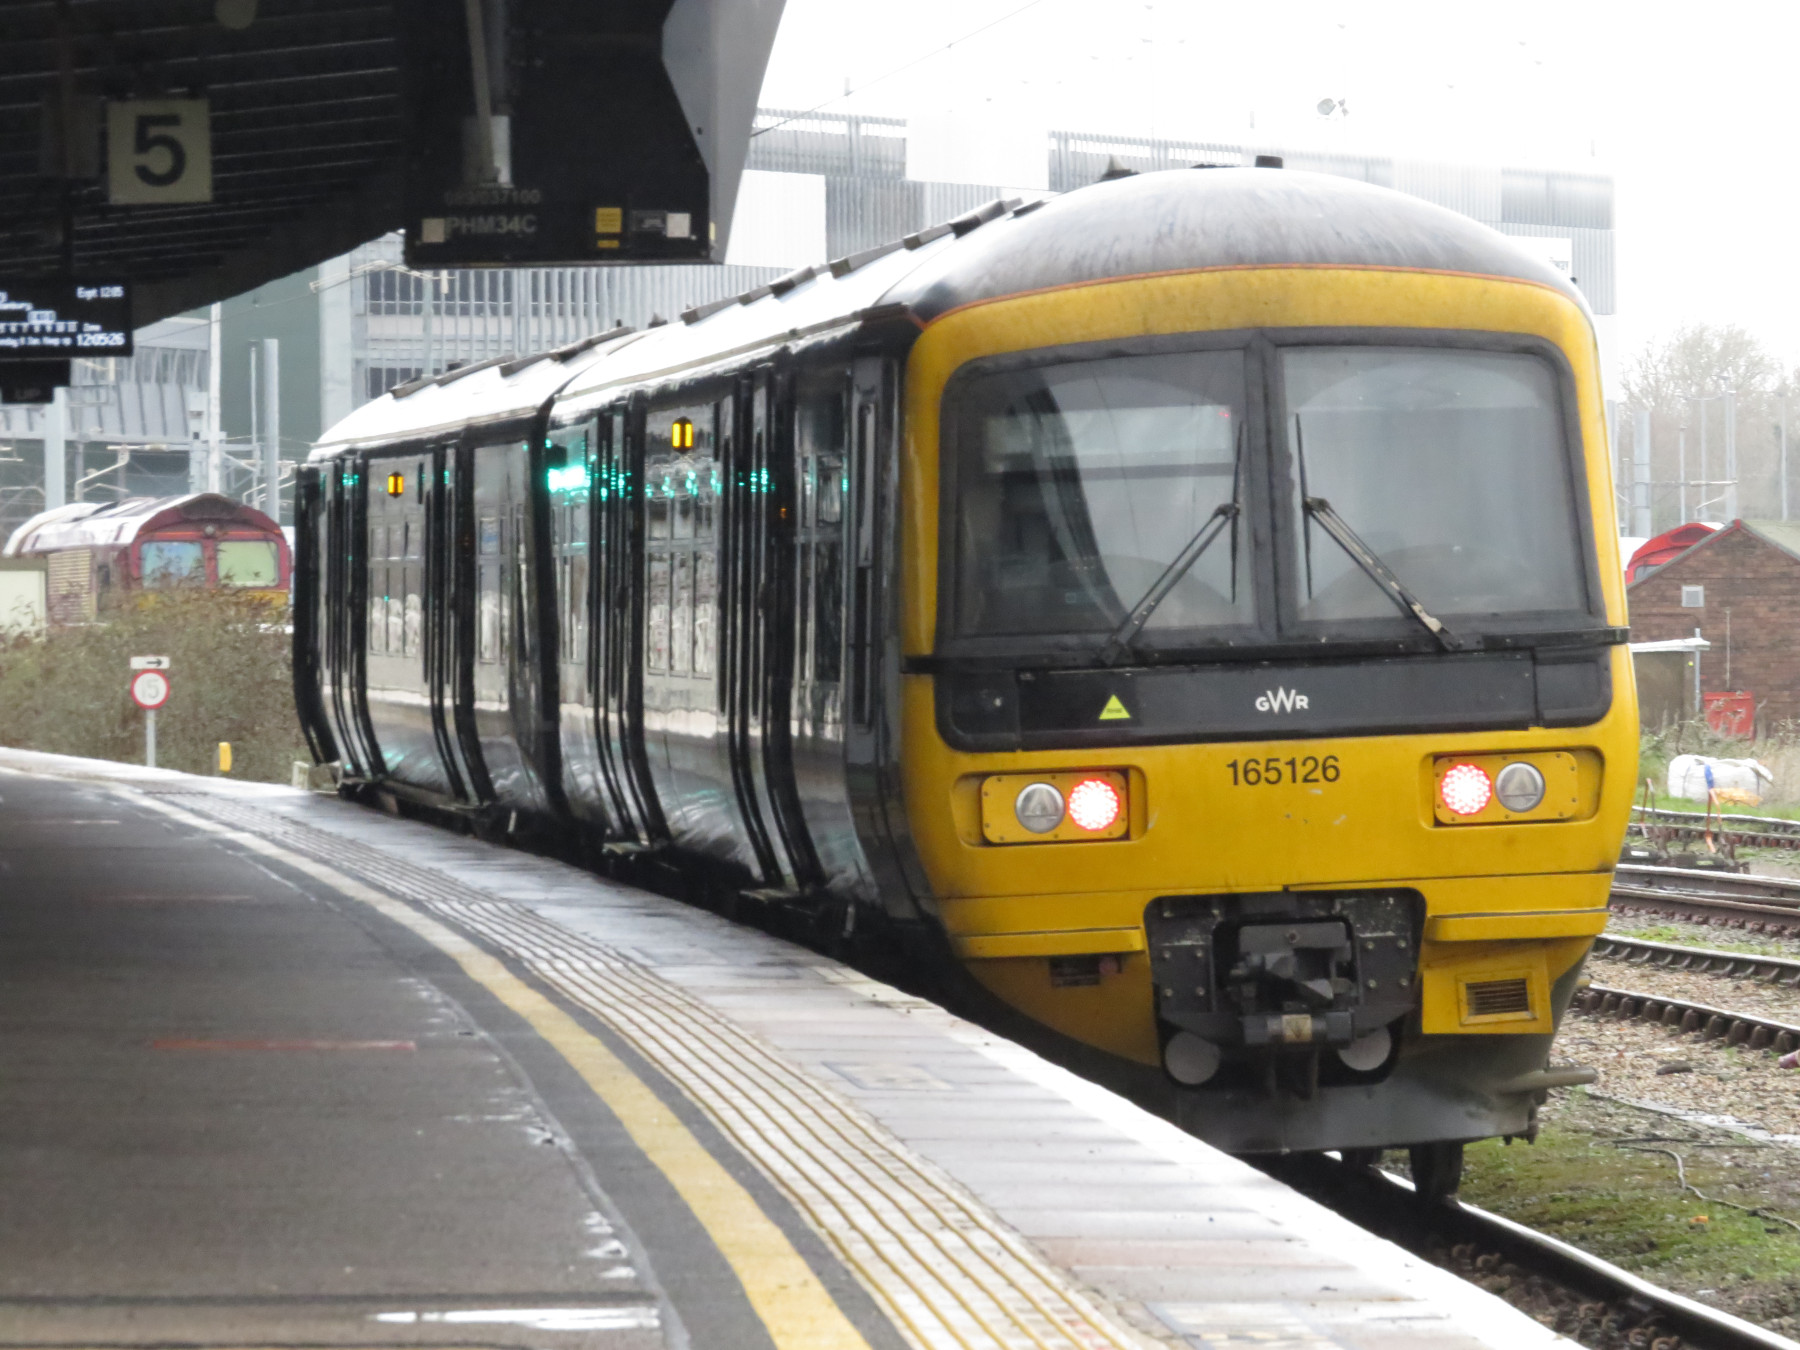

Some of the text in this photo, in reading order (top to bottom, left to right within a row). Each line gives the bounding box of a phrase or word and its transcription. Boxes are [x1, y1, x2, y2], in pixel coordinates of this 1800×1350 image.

[134, 114, 186, 187] 5
[445, 214, 538, 235] PHM34C
[76, 333, 125, 346] 12:05:26
[141, 679, 160, 699] 15
[1255, 686, 1309, 714] GWR
[1226, 755, 1341, 786] 165126
